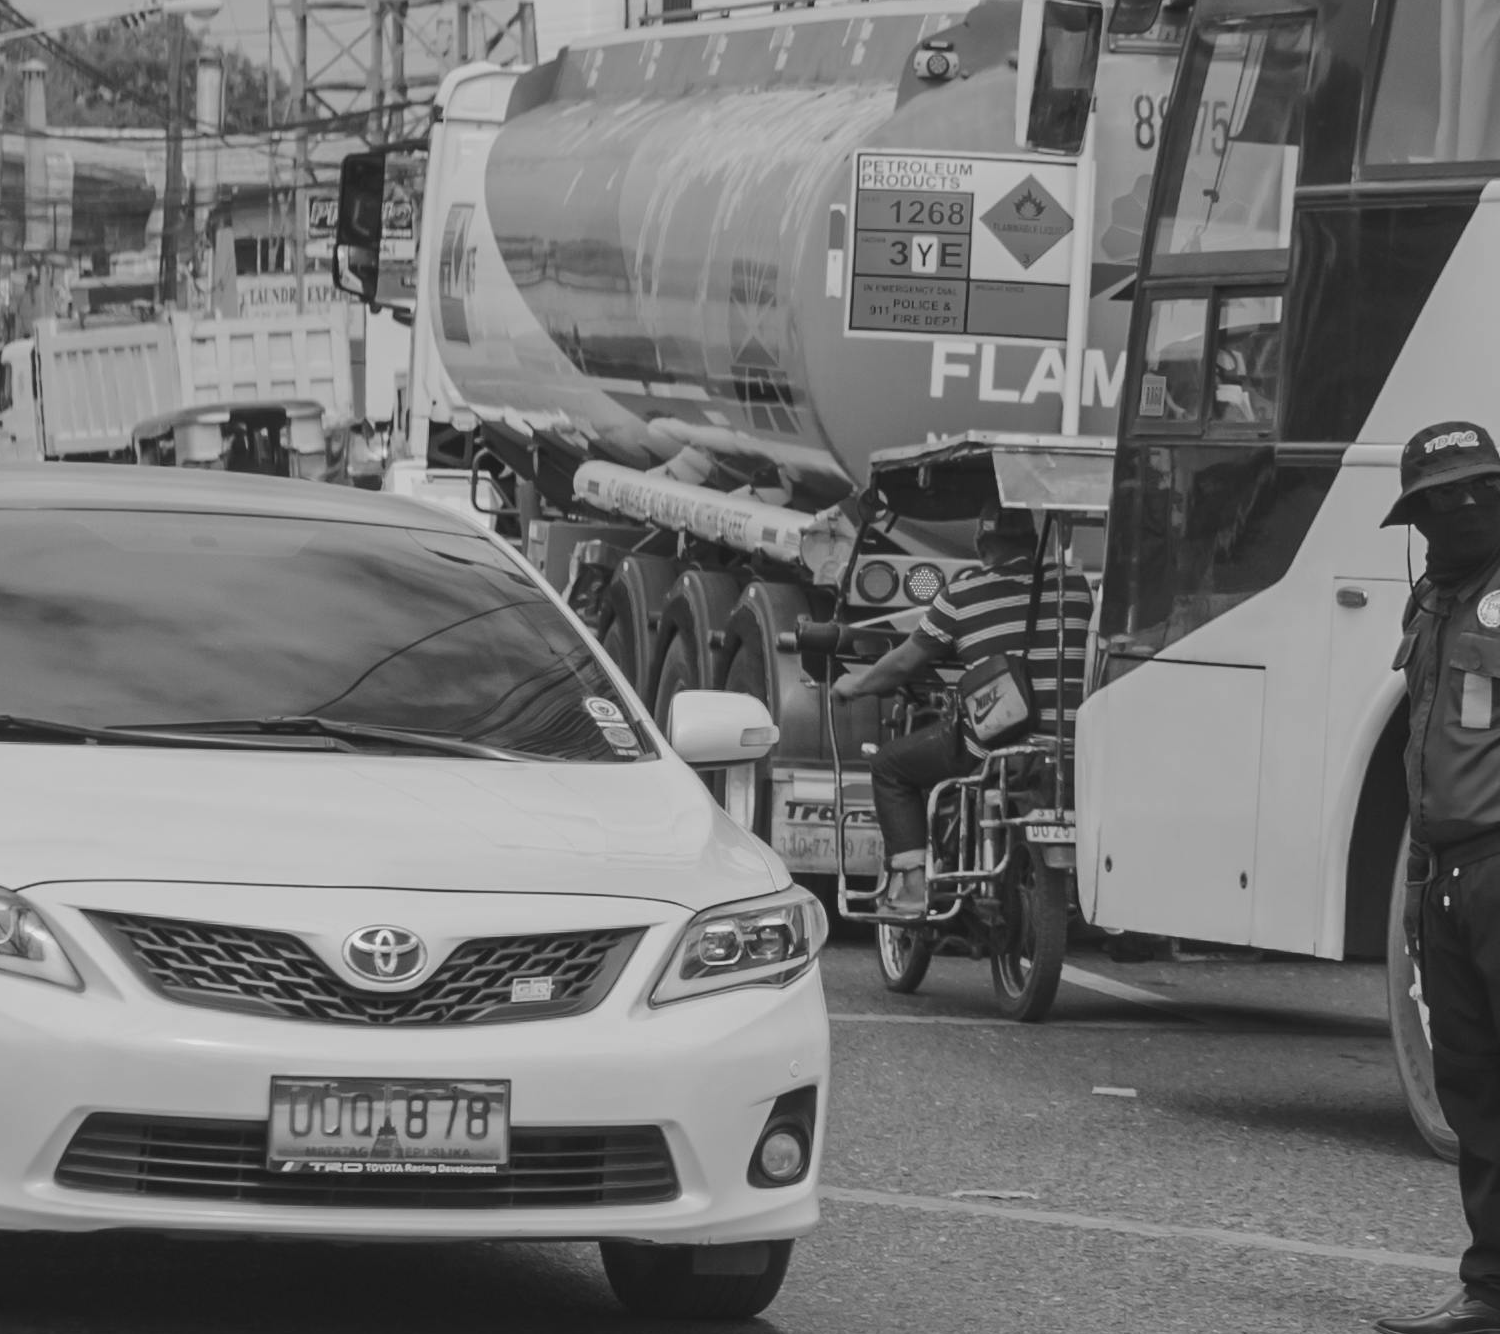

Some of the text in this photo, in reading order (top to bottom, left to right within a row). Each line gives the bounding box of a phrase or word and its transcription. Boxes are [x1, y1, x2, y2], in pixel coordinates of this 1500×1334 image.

[1134, 94, 1229, 157] 875
[861, 159, 973, 175] PETROLEUM
[861, 174, 960, 188] PRODUCTS
[889, 199, 965, 226] 1268
[250, 287, 296, 305] LAUNDR
[869, 298, 951, 316] 911 POLICE &
[892, 314, 958, 327] FIRE DEPT
[976, 684, 999, 713] NIKE
[405, 1094, 491, 1140] 878
[309, 1162, 498, 1174] TRD TOYOTA Racing Development
